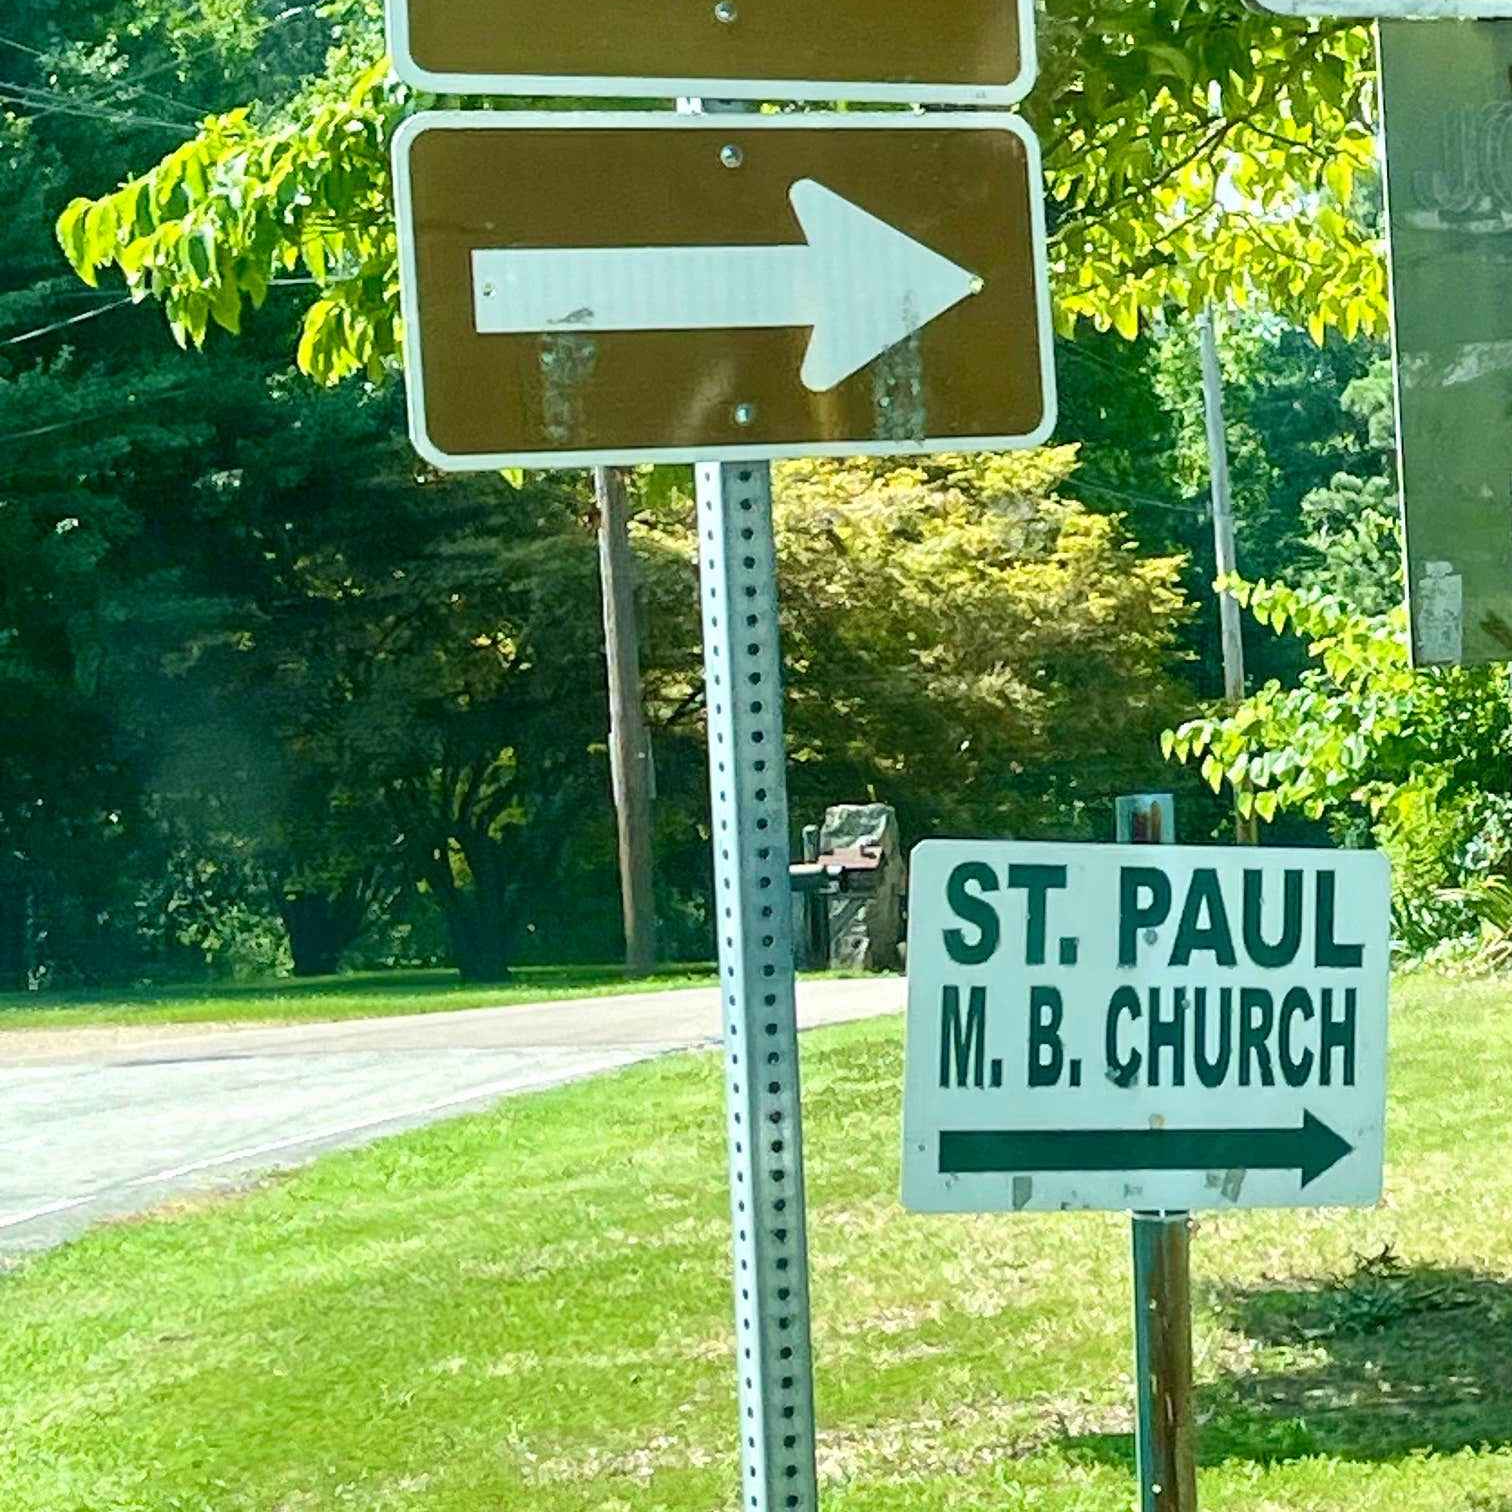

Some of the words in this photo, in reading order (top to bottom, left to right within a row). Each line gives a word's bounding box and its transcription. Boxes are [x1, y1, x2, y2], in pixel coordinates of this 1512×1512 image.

[941, 861, 1080, 967] ST.
[1117, 865, 1366, 970] PAUL
[1104, 984, 1358, 1089] CHURCH
